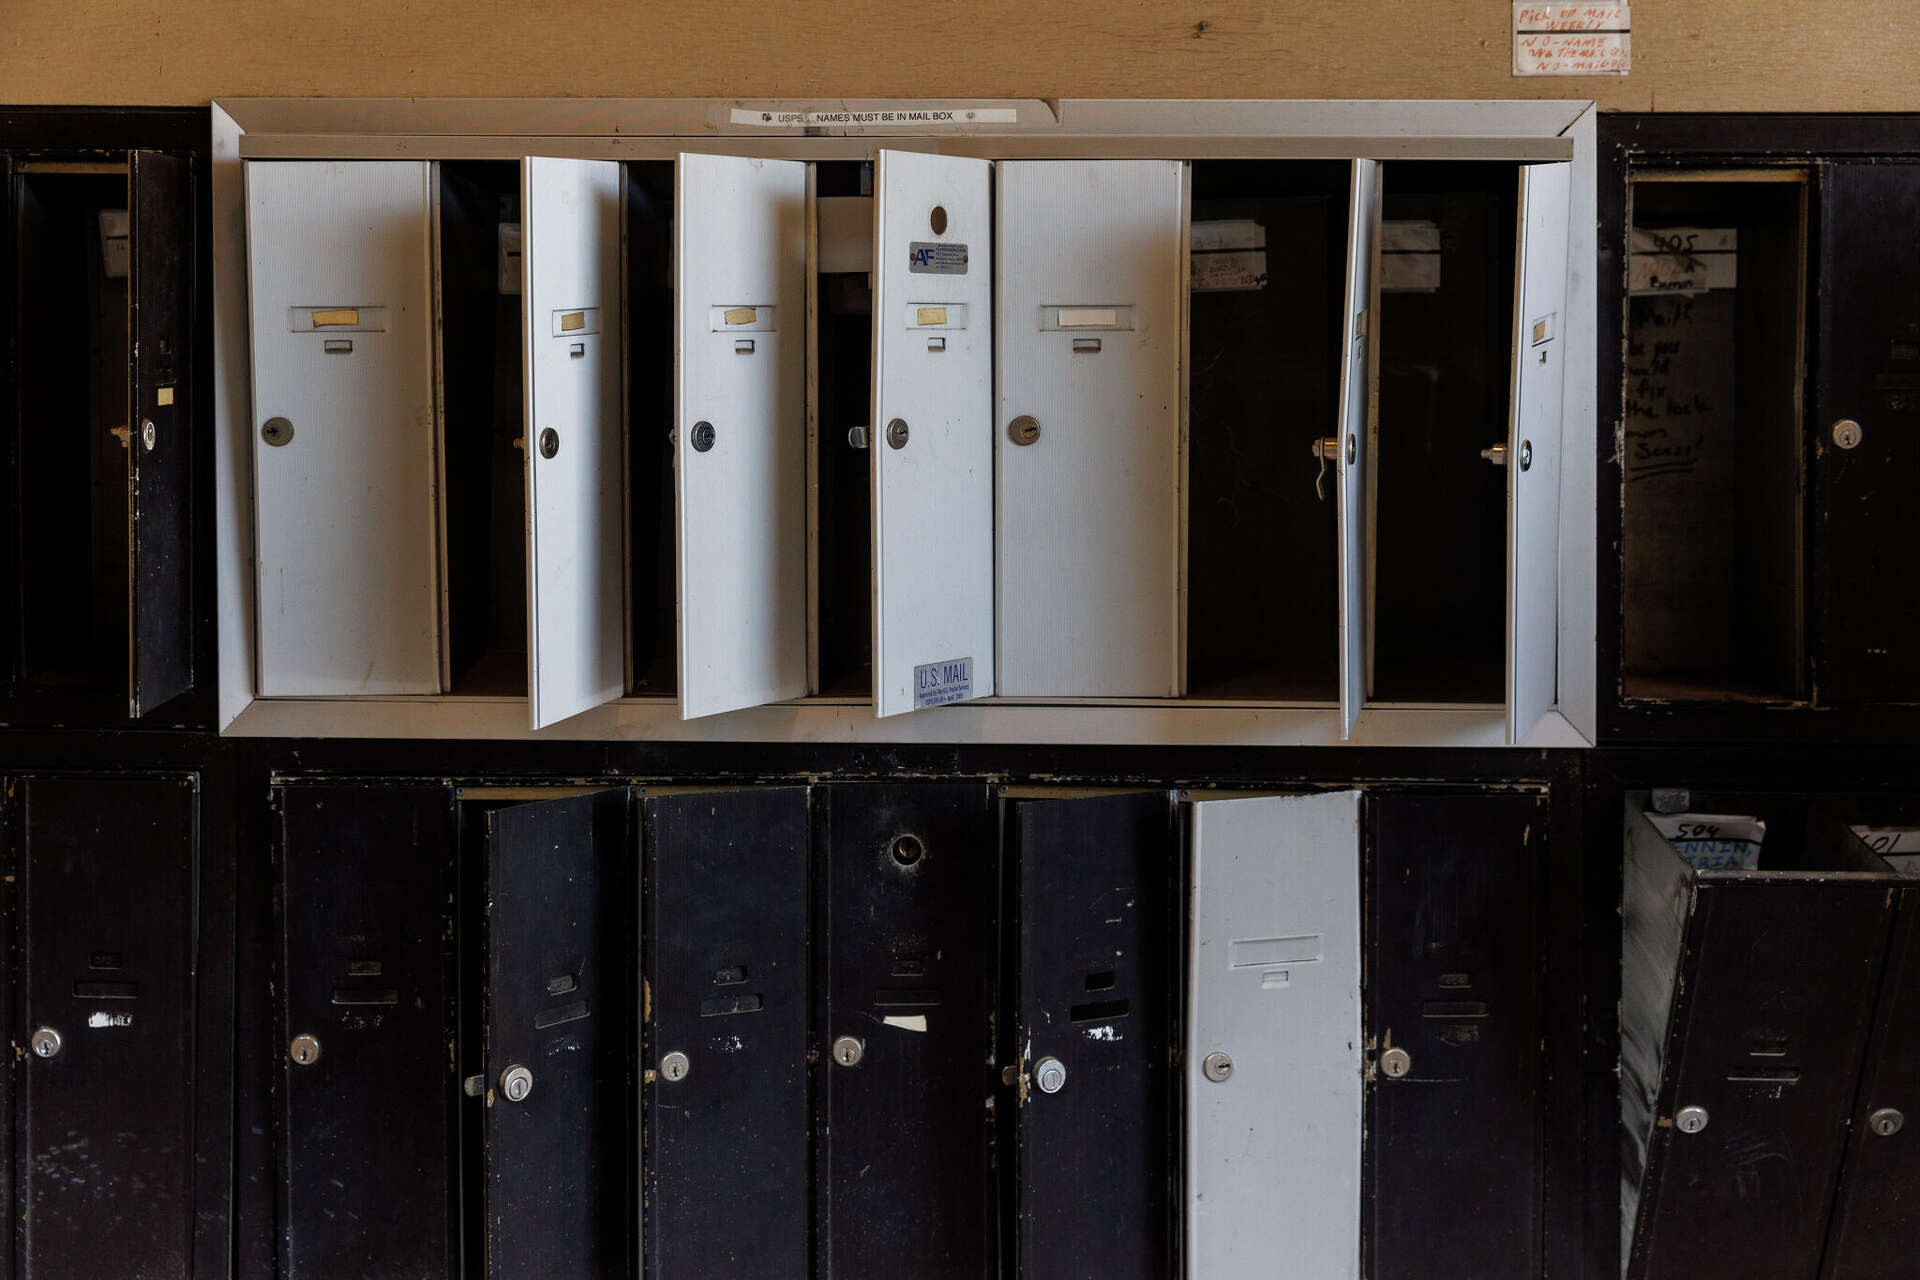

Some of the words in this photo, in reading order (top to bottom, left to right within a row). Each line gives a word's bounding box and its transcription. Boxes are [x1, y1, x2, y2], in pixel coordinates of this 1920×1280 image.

[817, 113, 850, 122] NAMES
[852, 112, 880, 122] MUST
[882, 112, 894, 121] BE
[897, 112, 906, 121] IN
[908, 112, 931, 121] MAIL
[933, 112, 953, 121] BOX
[913, 249, 935, 266] AF
[920, 668, 940, 689] U.S.
[944, 663, 968, 684] MAIL
[1675, 823, 1721, 839] 504
[1862, 833, 1901, 853] 01
